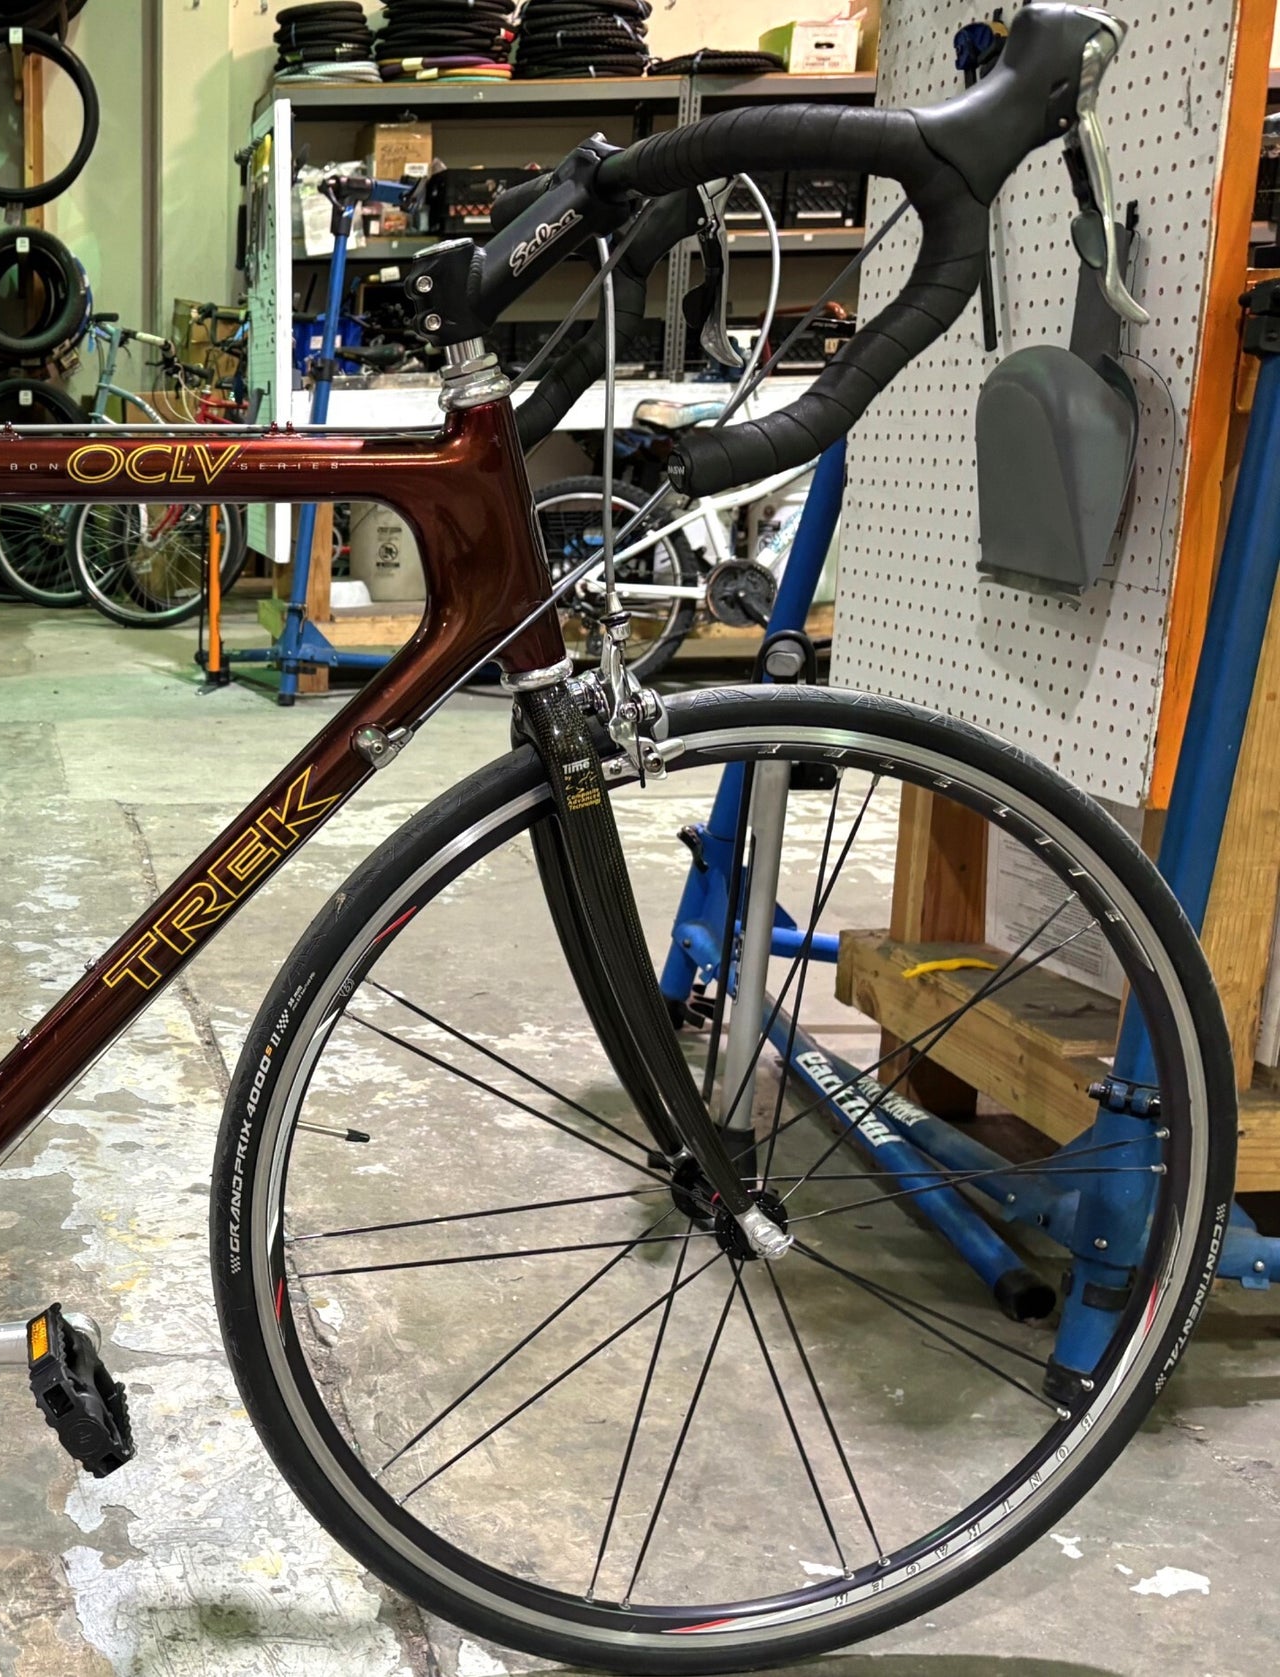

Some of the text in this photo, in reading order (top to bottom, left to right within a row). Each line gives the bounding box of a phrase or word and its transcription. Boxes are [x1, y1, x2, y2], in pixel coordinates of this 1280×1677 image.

[509, 209, 583, 277] Salsa
[66, 444, 241, 485] OCLV
[240, 462, 340, 471] SERIES
[562, 757, 591, 775] Time
[102, 765, 343, 990] TREK
[234, 1121, 252, 1173] PRIX
[229, 1174, 243, 1253] GRAND
[1163, 1223, 1223, 1372] CONTINENTAL
[834, 1413, 1094, 1607] BONTRAGER
